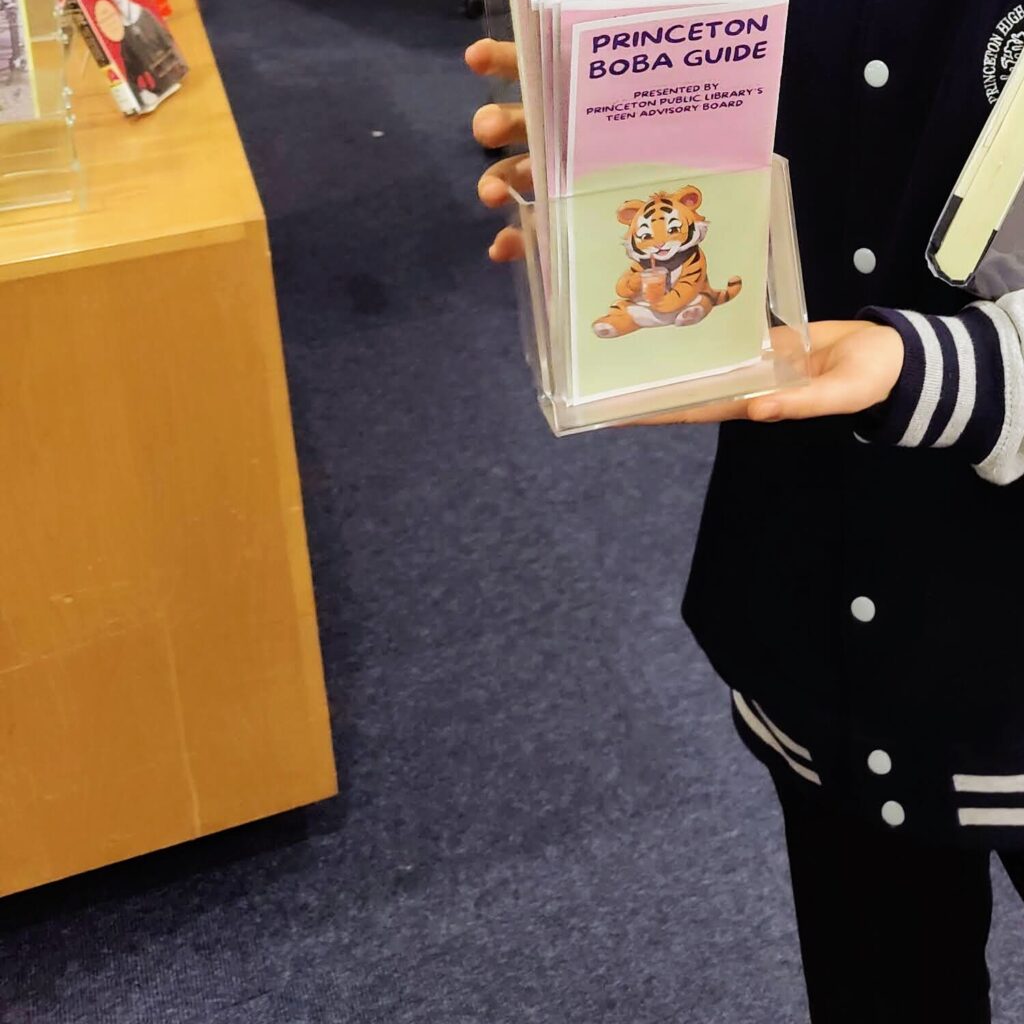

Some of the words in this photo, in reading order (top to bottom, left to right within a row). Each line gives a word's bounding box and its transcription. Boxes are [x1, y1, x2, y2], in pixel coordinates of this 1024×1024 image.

[592, 14, 769, 54] PRINCETON
[589, 53, 673, 79] BOBA
[683, 41, 768, 67] GUIDE
[983, 33, 1004, 104] PRINCETON
[586, 99, 657, 115] PRINCETON
[659, 94, 701, 106] PUBLIC
[704, 87, 763, 101] LIBRARY'S
[633, 85, 701, 99] PRESENTED
[703, 83, 719, 92] BY
[606, 112, 636, 122] TEEN
[639, 105, 699, 117] ADVISORY
[702, 99, 743, 111] BOARD
